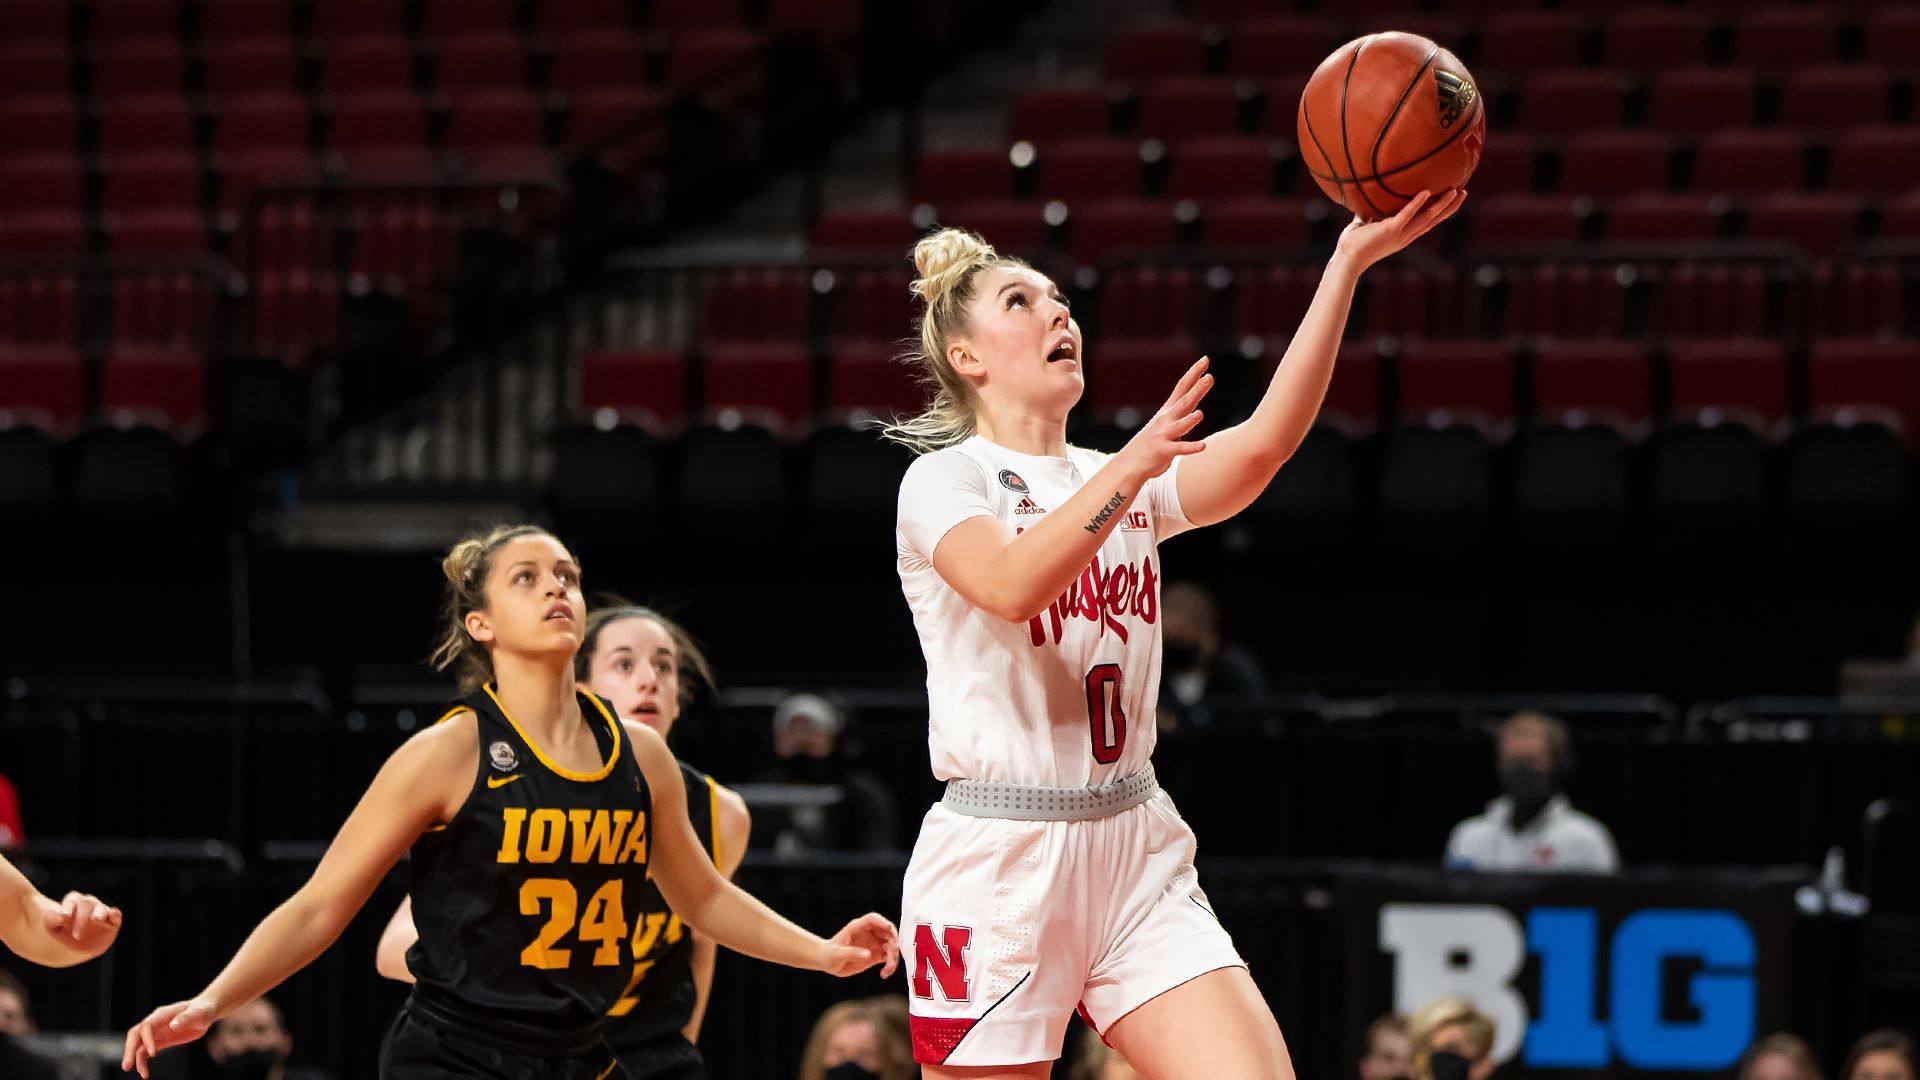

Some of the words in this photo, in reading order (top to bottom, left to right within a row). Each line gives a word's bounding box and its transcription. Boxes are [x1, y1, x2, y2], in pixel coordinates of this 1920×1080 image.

[1014, 506, 1047, 515] adidas
[1085, 663, 1127, 764] 0
[497, 807, 646, 864] IOWA
[519, 877, 628, 970] 24
[911, 922, 973, 1003] N
